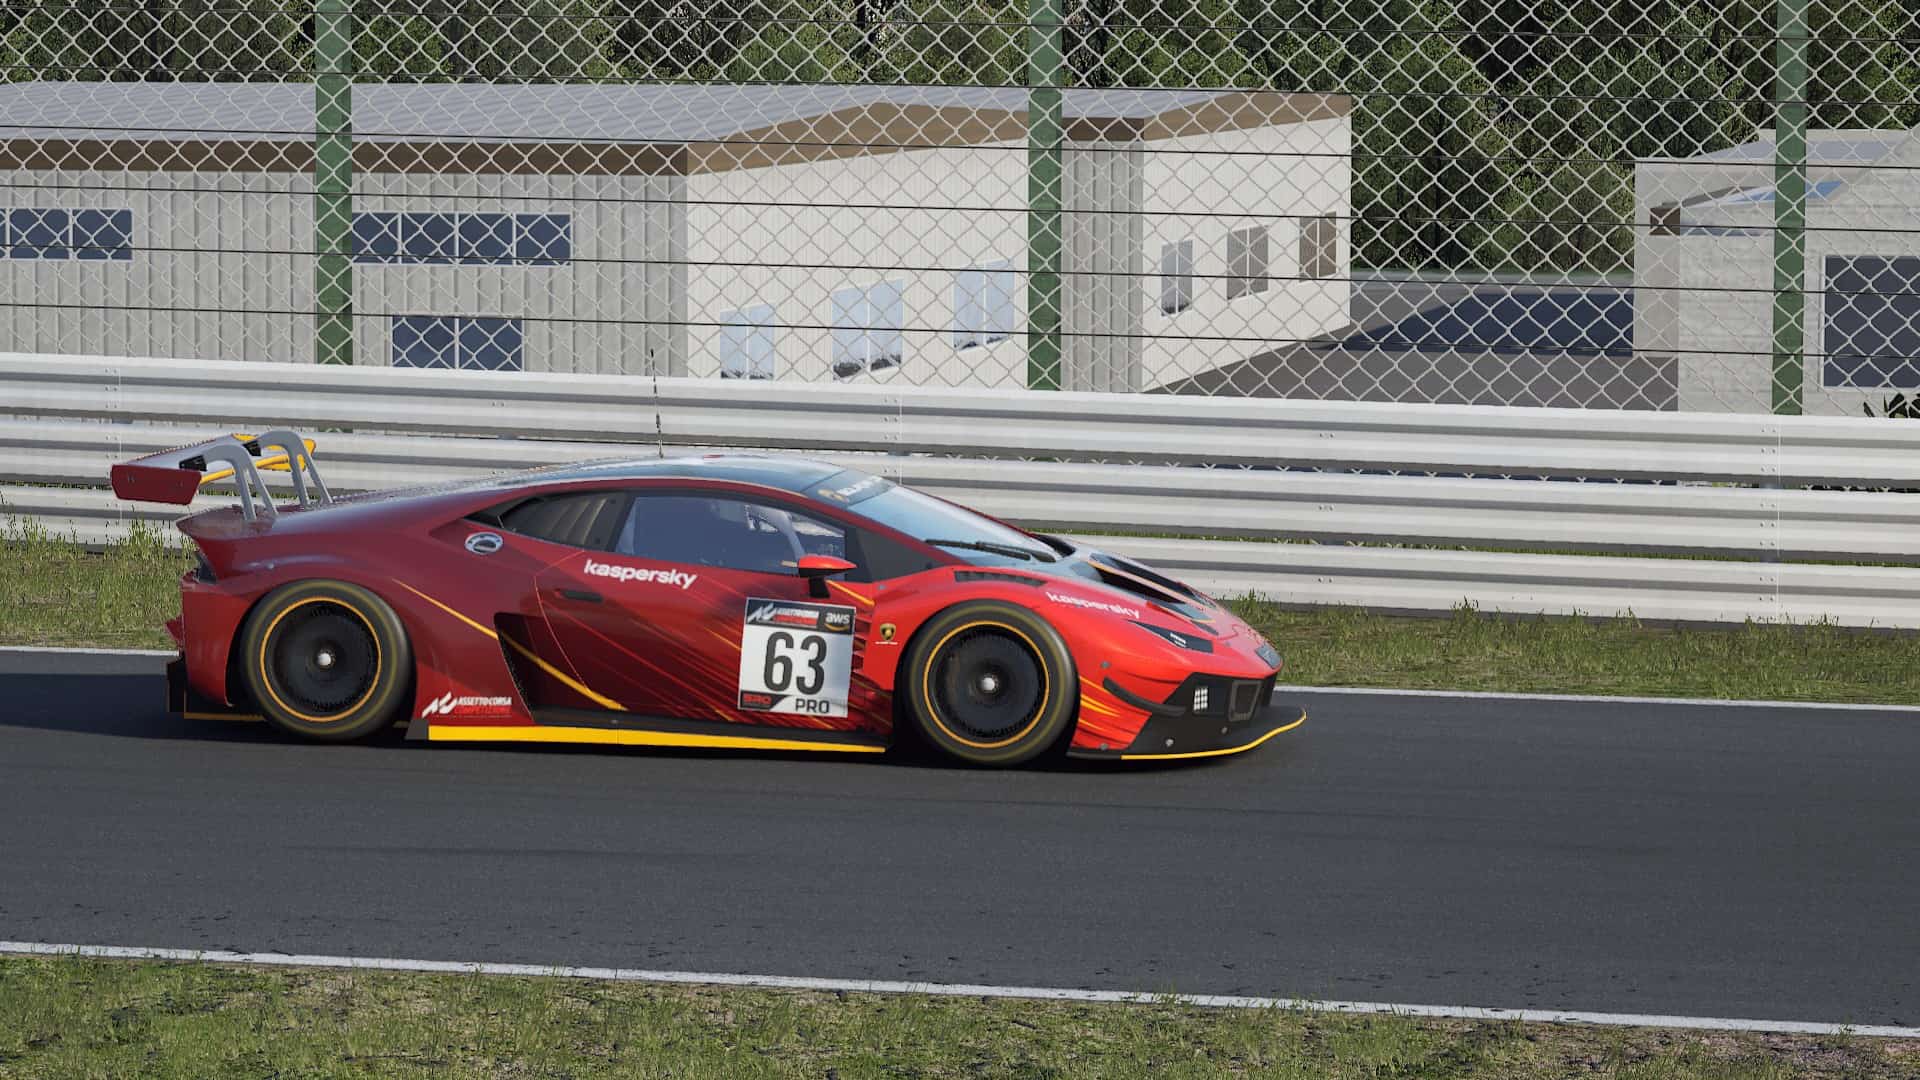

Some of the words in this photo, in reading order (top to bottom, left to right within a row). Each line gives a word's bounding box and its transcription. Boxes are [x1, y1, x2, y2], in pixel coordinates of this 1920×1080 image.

[583, 558, 698, 589] kaspersky
[825, 612, 850, 624] aws
[1045, 591, 1140, 619] kaspersky
[763, 631, 827, 695] 63
[795, 698, 830, 714] PRO
